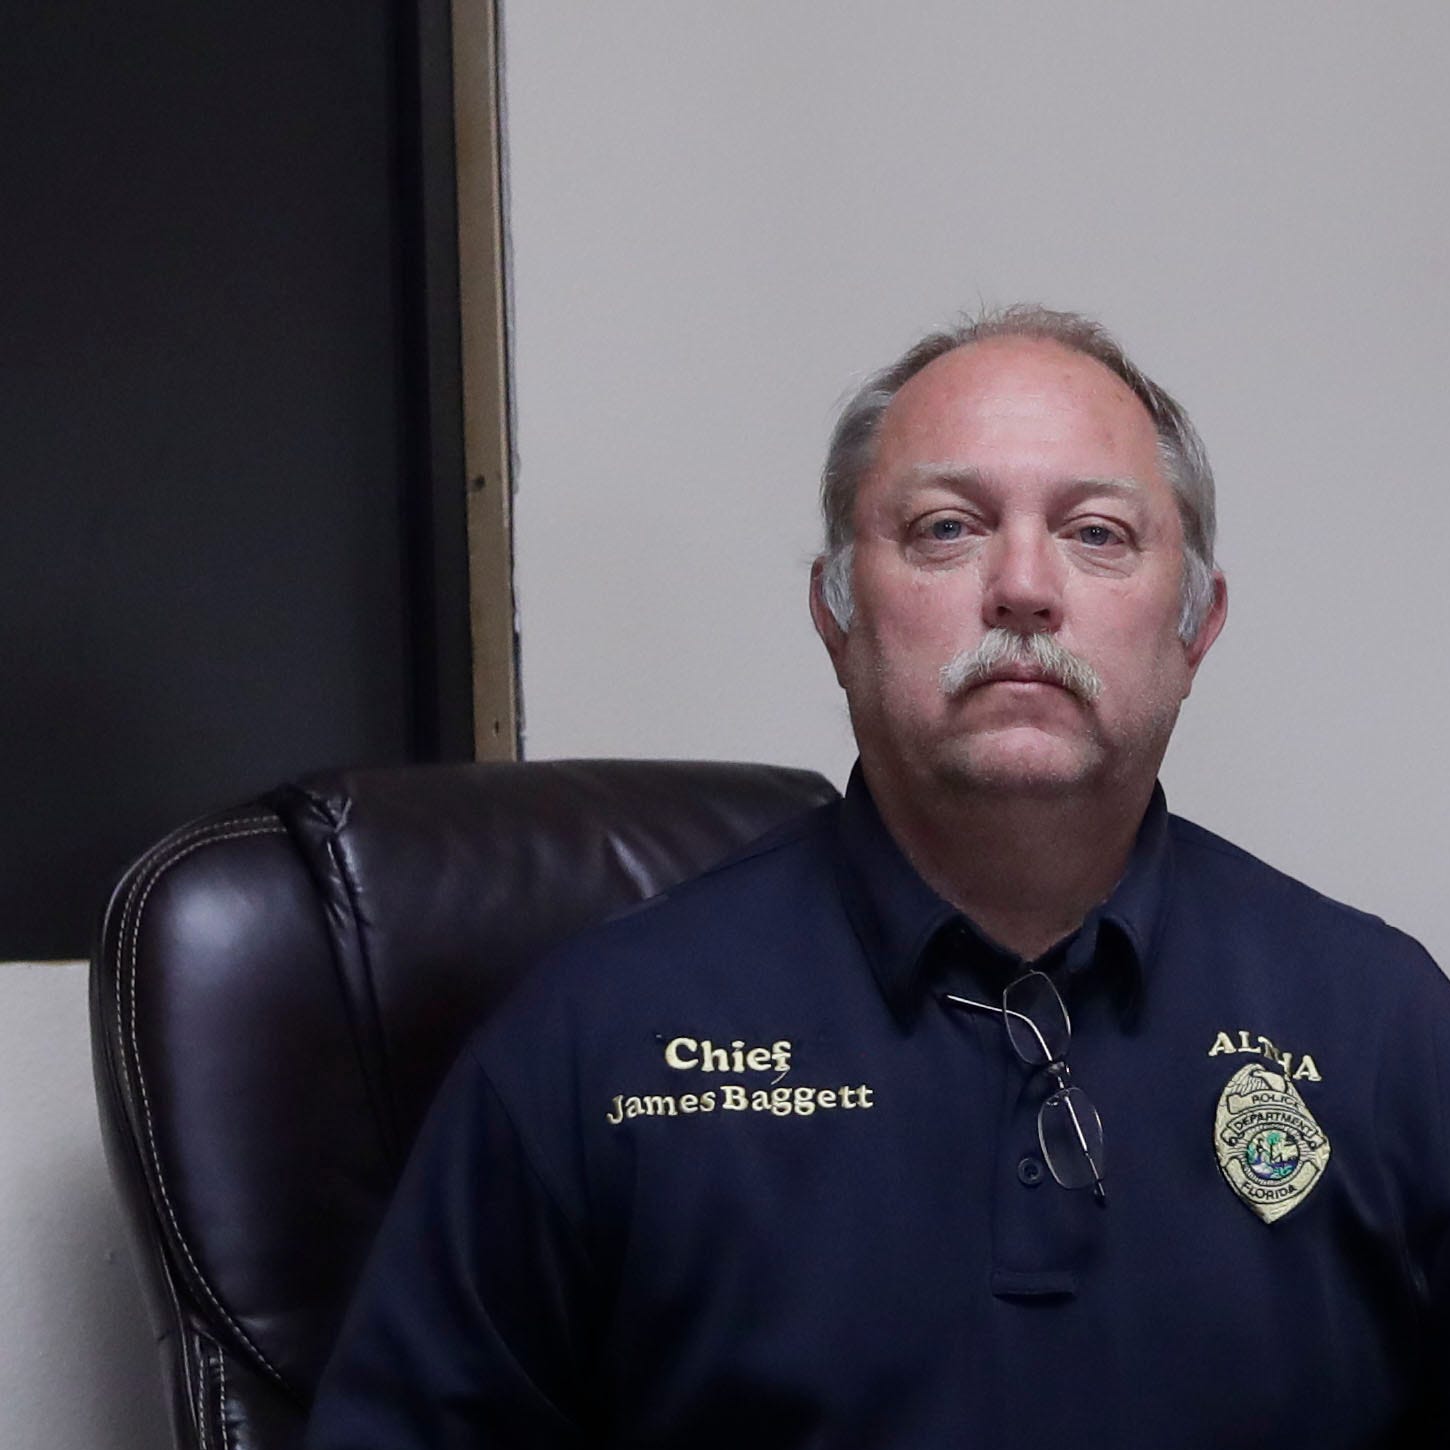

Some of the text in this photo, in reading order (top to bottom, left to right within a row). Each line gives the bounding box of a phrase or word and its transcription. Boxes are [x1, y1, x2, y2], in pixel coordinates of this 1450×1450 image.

[665, 1037, 792, 1073] Chief
[607, 1084, 874, 1125] James Baggett
[1234, 1112, 1314, 1135] DEPARTMENT
[1241, 1181, 1297, 1200] FLORIDA
